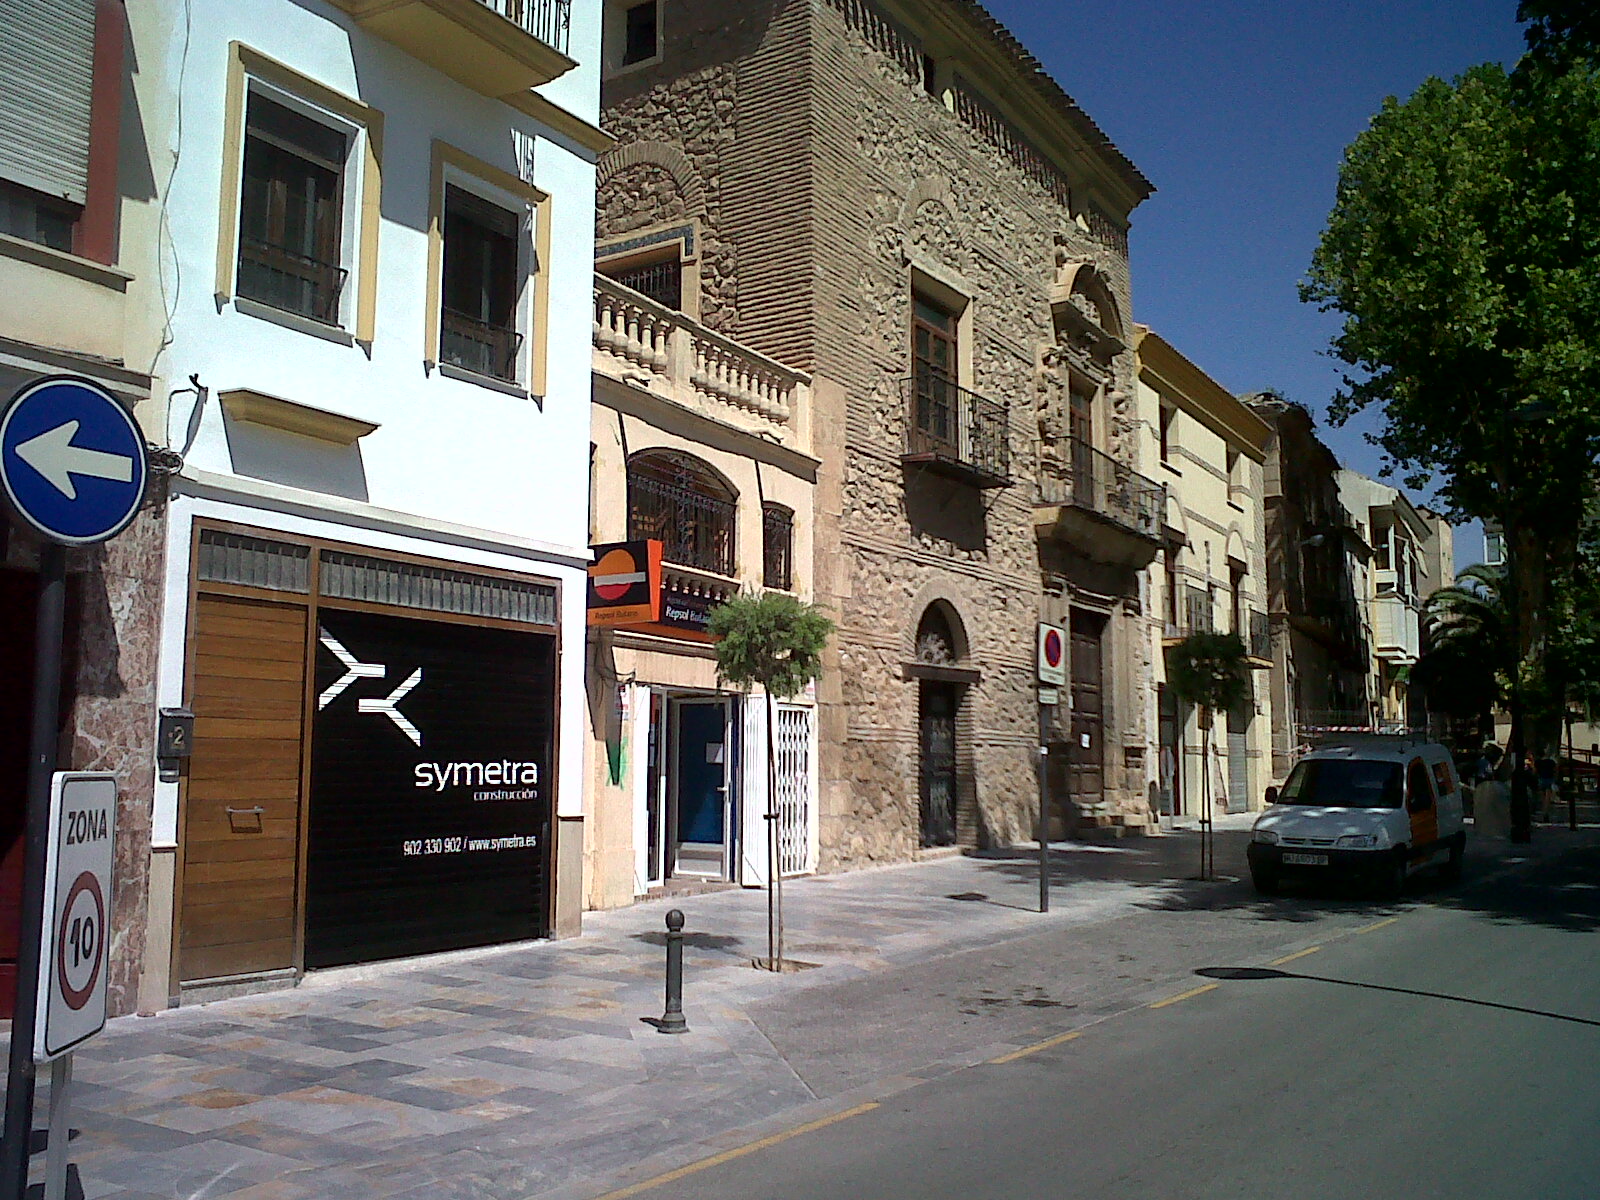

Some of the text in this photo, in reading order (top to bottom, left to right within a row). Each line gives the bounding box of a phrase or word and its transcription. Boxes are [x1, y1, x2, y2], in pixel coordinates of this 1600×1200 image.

[665, 605, 689, 620] Repsol
[174, 725, 185, 745] 2
[414, 759, 538, 791] symetra
[473, 788, 538, 801] construcción
[66, 809, 108, 845] ZONA
[403, 840, 422, 856] 902
[424, 838, 442, 854] 330
[444, 837, 461, 853] 902
[468, 834, 537, 851] www.symetra.es
[70, 916, 94, 968] 10
